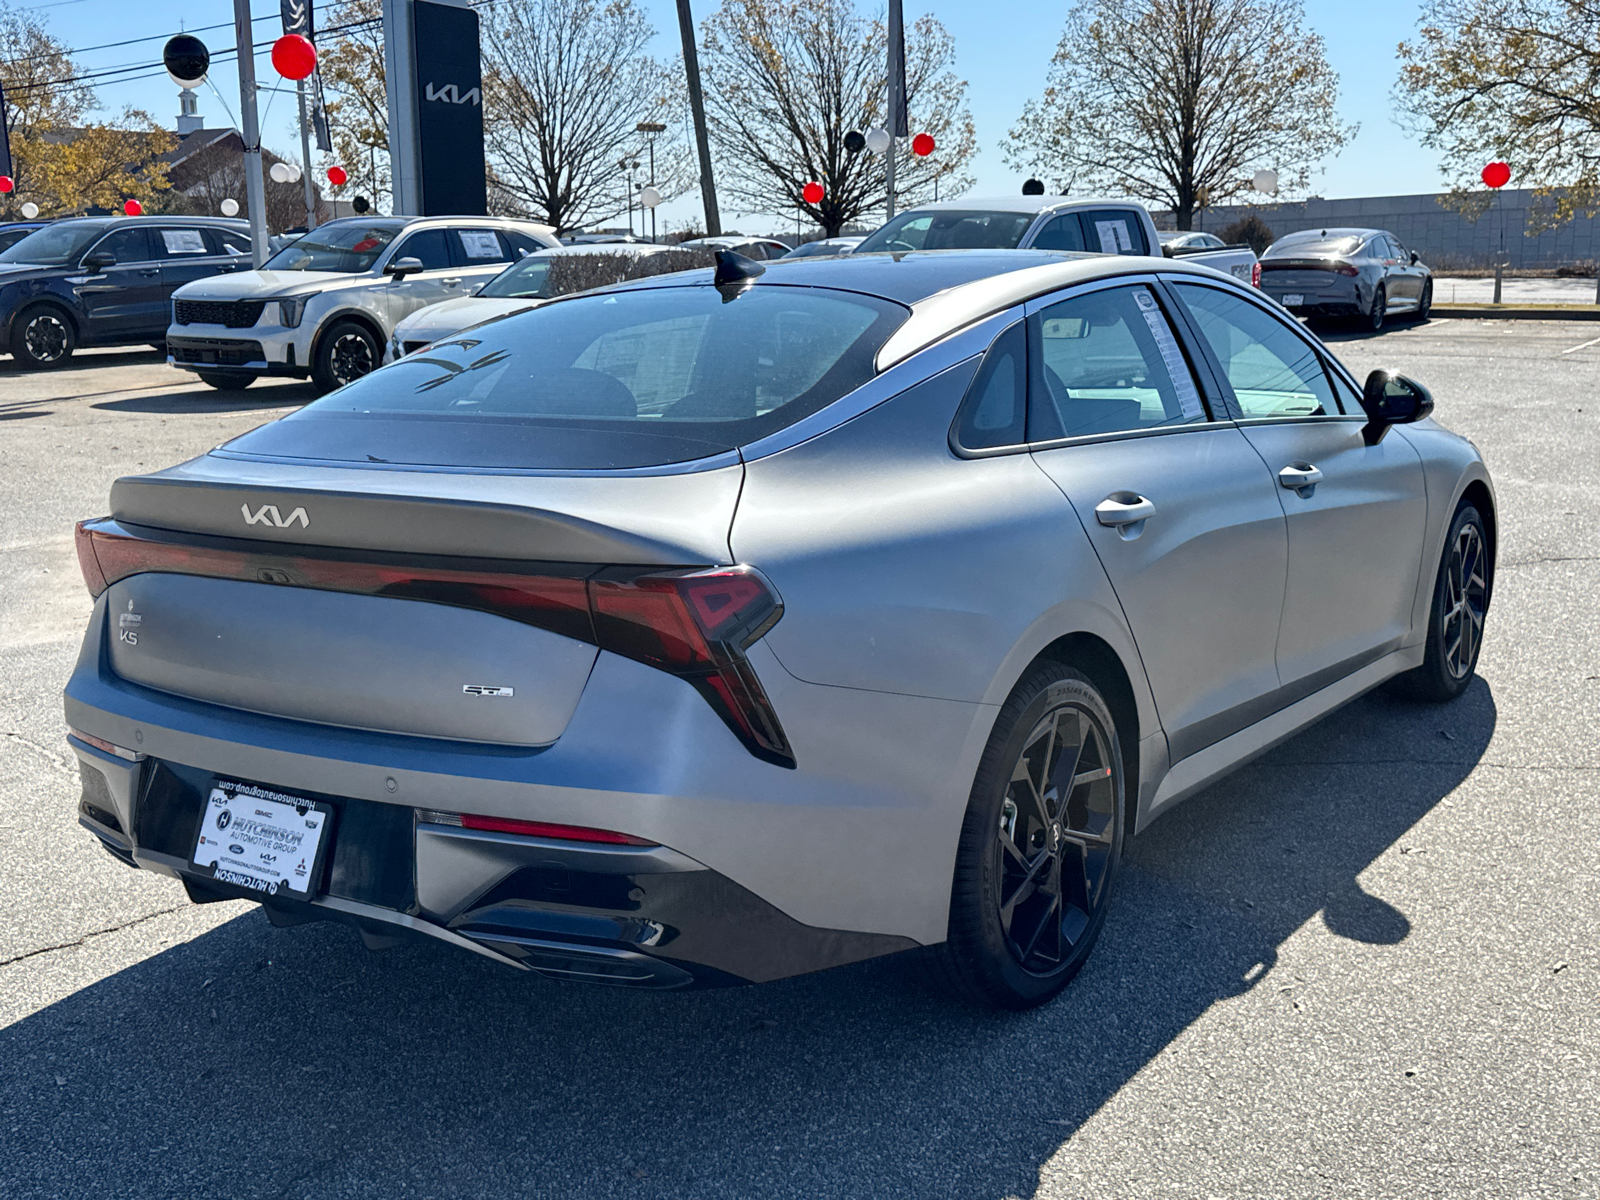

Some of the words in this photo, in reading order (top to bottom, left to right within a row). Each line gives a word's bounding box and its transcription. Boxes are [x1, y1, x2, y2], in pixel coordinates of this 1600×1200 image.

[426, 81, 480, 107] KIA
[241, 502, 310, 529] KIA
[120, 629, 138, 646] K5
[219, 780, 316, 811] Hutchinsonautogroup.com
[230, 830, 273, 849] AUTOMOTIVE
[273, 841, 298, 854] GROUP
[231, 816, 305, 846] HUTCHINSON
[213, 867, 268, 892] HUTCHINSON
